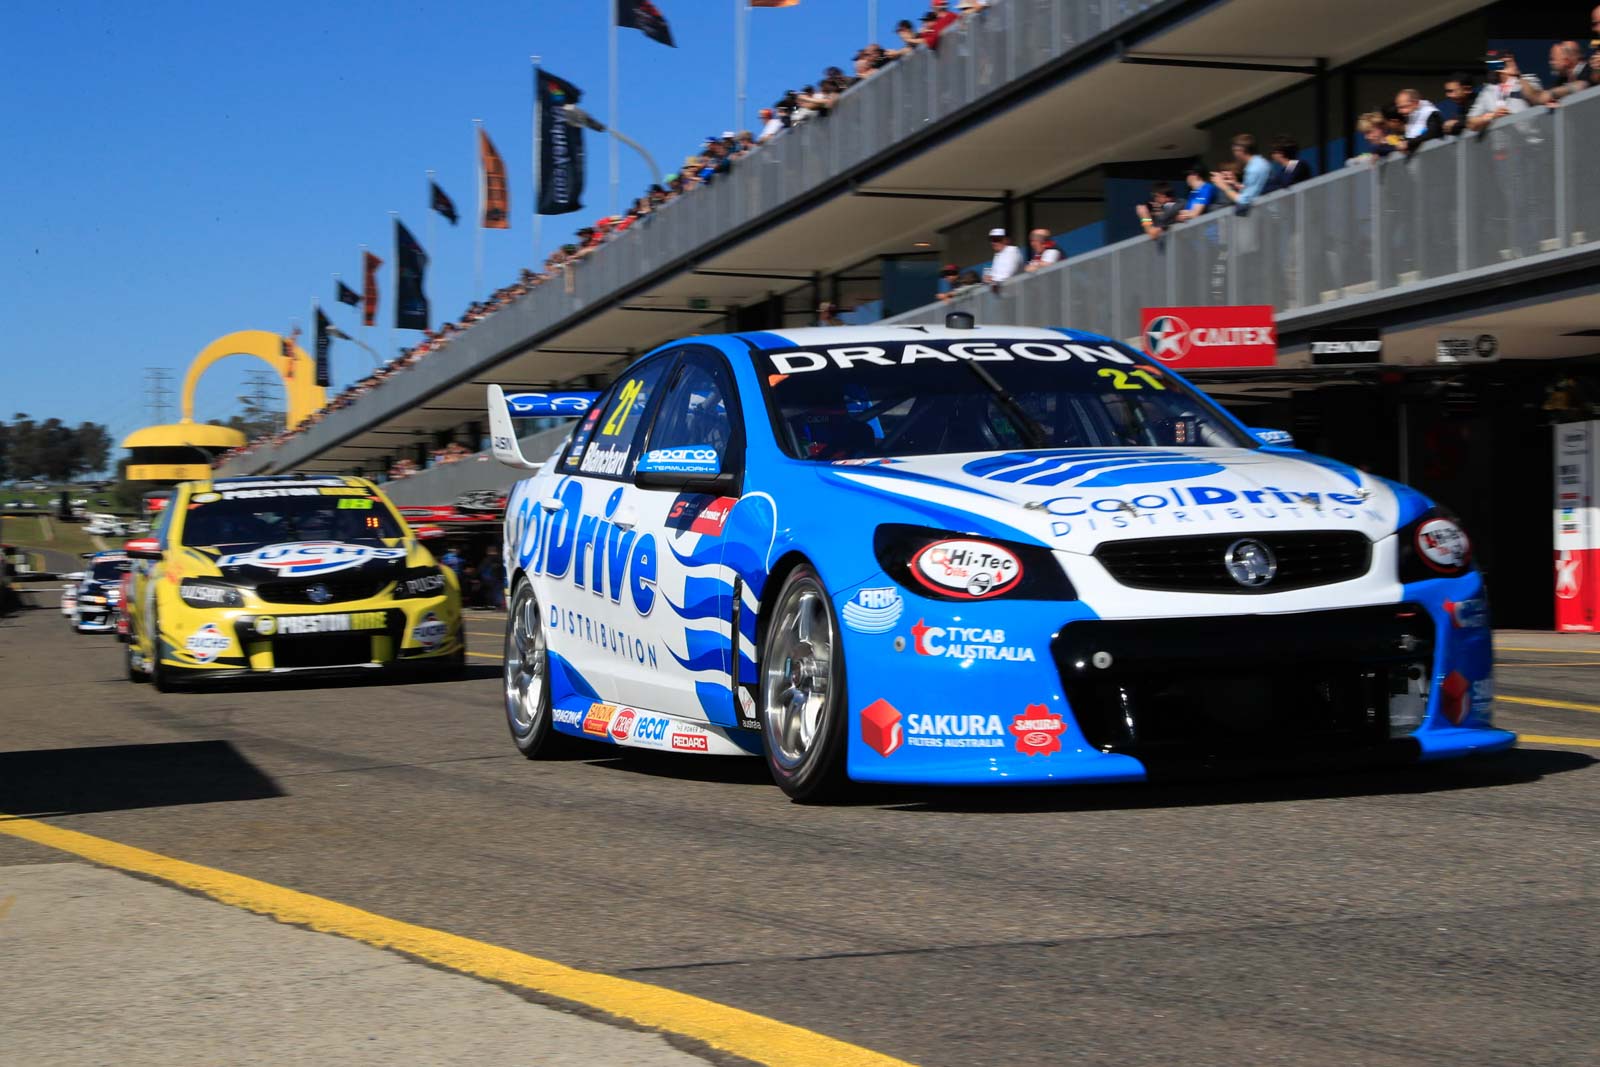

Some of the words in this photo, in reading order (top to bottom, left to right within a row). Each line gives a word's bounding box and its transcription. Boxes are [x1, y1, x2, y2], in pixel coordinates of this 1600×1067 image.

[1189, 326, 1276, 346] CALTEX
[769, 343, 1135, 375] DRAGON
[1097, 368, 1166, 390] 21
[602, 379, 644, 436] 21
[580, 442, 631, 475] Blanchard
[648, 450, 717, 463] sparco
[1043, 486, 1367, 516] CoolDrive
[1051, 507, 1385, 537] DISTRIBUTION
[226, 546, 401, 565] FUCHS
[186, 636, 230, 649] FUCHS
[550, 604, 658, 672] DISTRIBUTION
[947, 627, 1006, 643] TYCAB
[945, 645, 1036, 662] AUSTRALIA
[633, 717, 669, 740] recar
[908, 713, 1005, 736] SAKURA
[1015, 718, 1061, 731] SAKURA
[673, 735, 706, 749] REDARC
[908, 736, 942, 748] FILTERS
[944, 737, 1005, 748] AUSTRALIA
